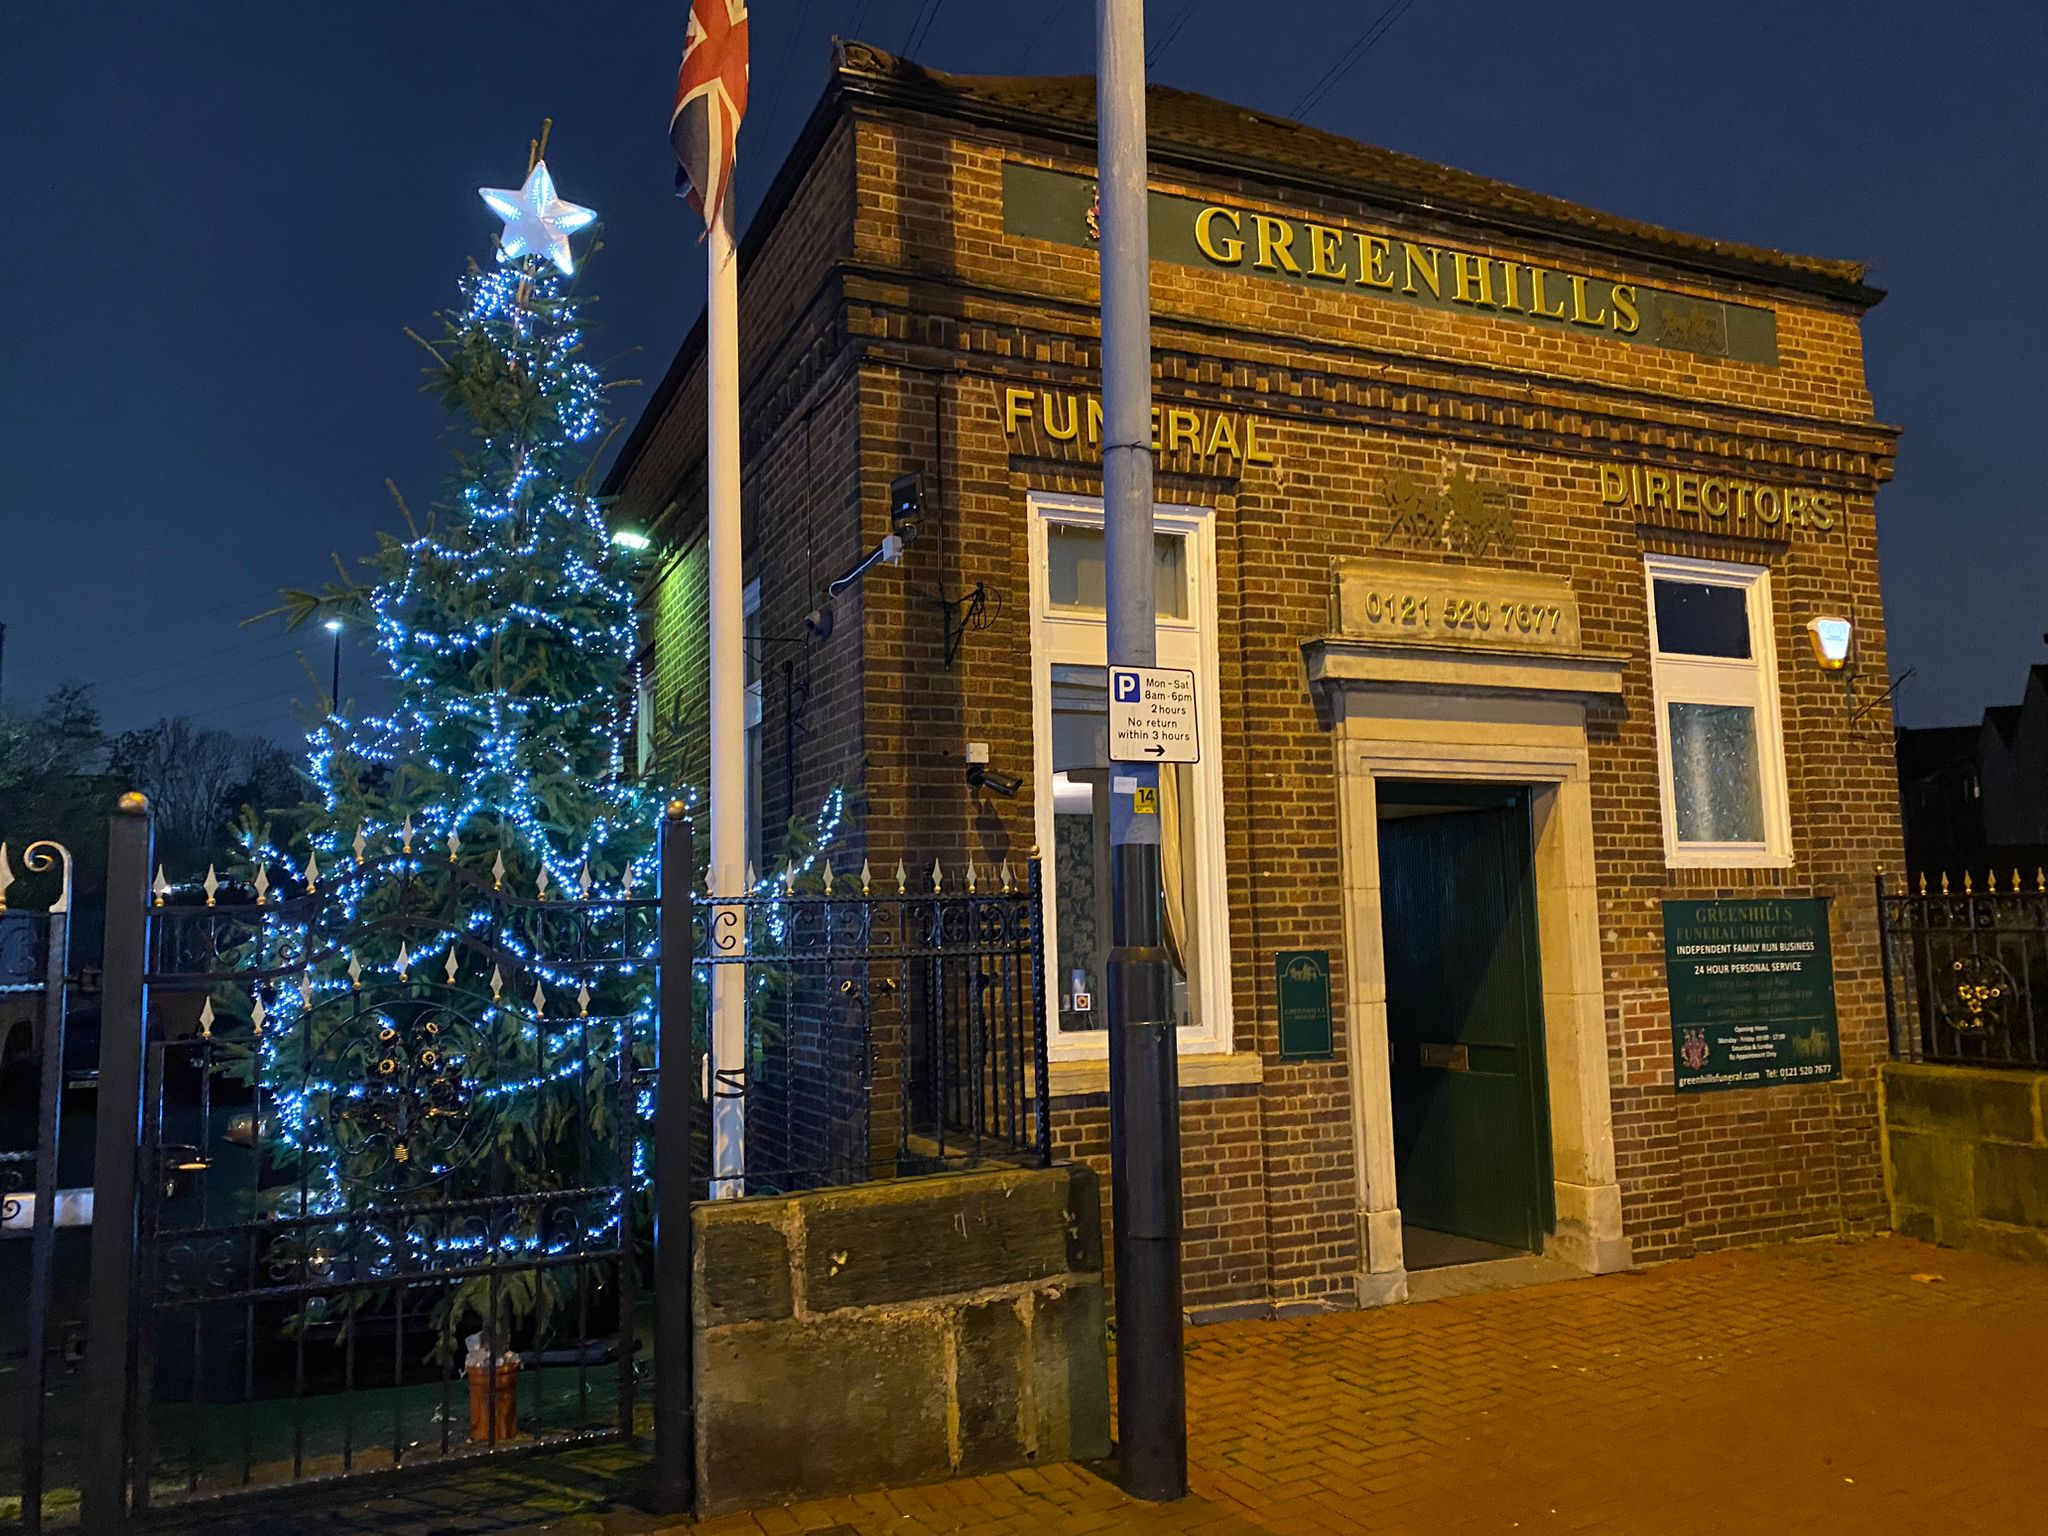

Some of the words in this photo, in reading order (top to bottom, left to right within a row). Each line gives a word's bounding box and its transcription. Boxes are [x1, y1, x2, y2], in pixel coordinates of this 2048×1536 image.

[1195, 206, 1640, 334] GREENHILLS
[1600, 463, 1835, 531] DIRECTORS
[1365, 591, 1429, 625] 0121
[1444, 597, 1491, 631] 520
[1500, 602, 1560, 635] 7677
[1151, 703, 1157, 713] 2
[1159, 704, 1186, 715] hours
[1128, 717, 1142, 727] No
[1146, 718, 1177, 728] return
[1118, 730, 1148, 740] within
[1152, 731, 1159, 740] 3
[1162, 731, 1190, 741] hours
[1138, 789, 1154, 803] 14
[1696, 906, 1793, 923] GREENHILLS
[1676, 926, 1738, 942] FUNERAL
[1676, 944, 1732, 955] INDEPENDENT
[1733, 943, 1760, 953] FAMILY
[1761, 942, 1778, 952] RUN
[1780, 941, 1815, 951] BUSINESS
[1694, 965, 1704, 975] 24
[1706, 964, 1730, 974] HOUR
[1731, 963, 1770, 974] PERSONAL
[1772, 961, 1802, 972] SERVICE
[1679, 1071, 1760, 1087] greenhillsfuneral.com
[1765, 1069, 1779, 1079] Tel:
[1780, 1067, 1797, 1077] 0121
[1799, 1066, 1814, 1075] 520
[1814, 1064, 1832, 1074] 7677
